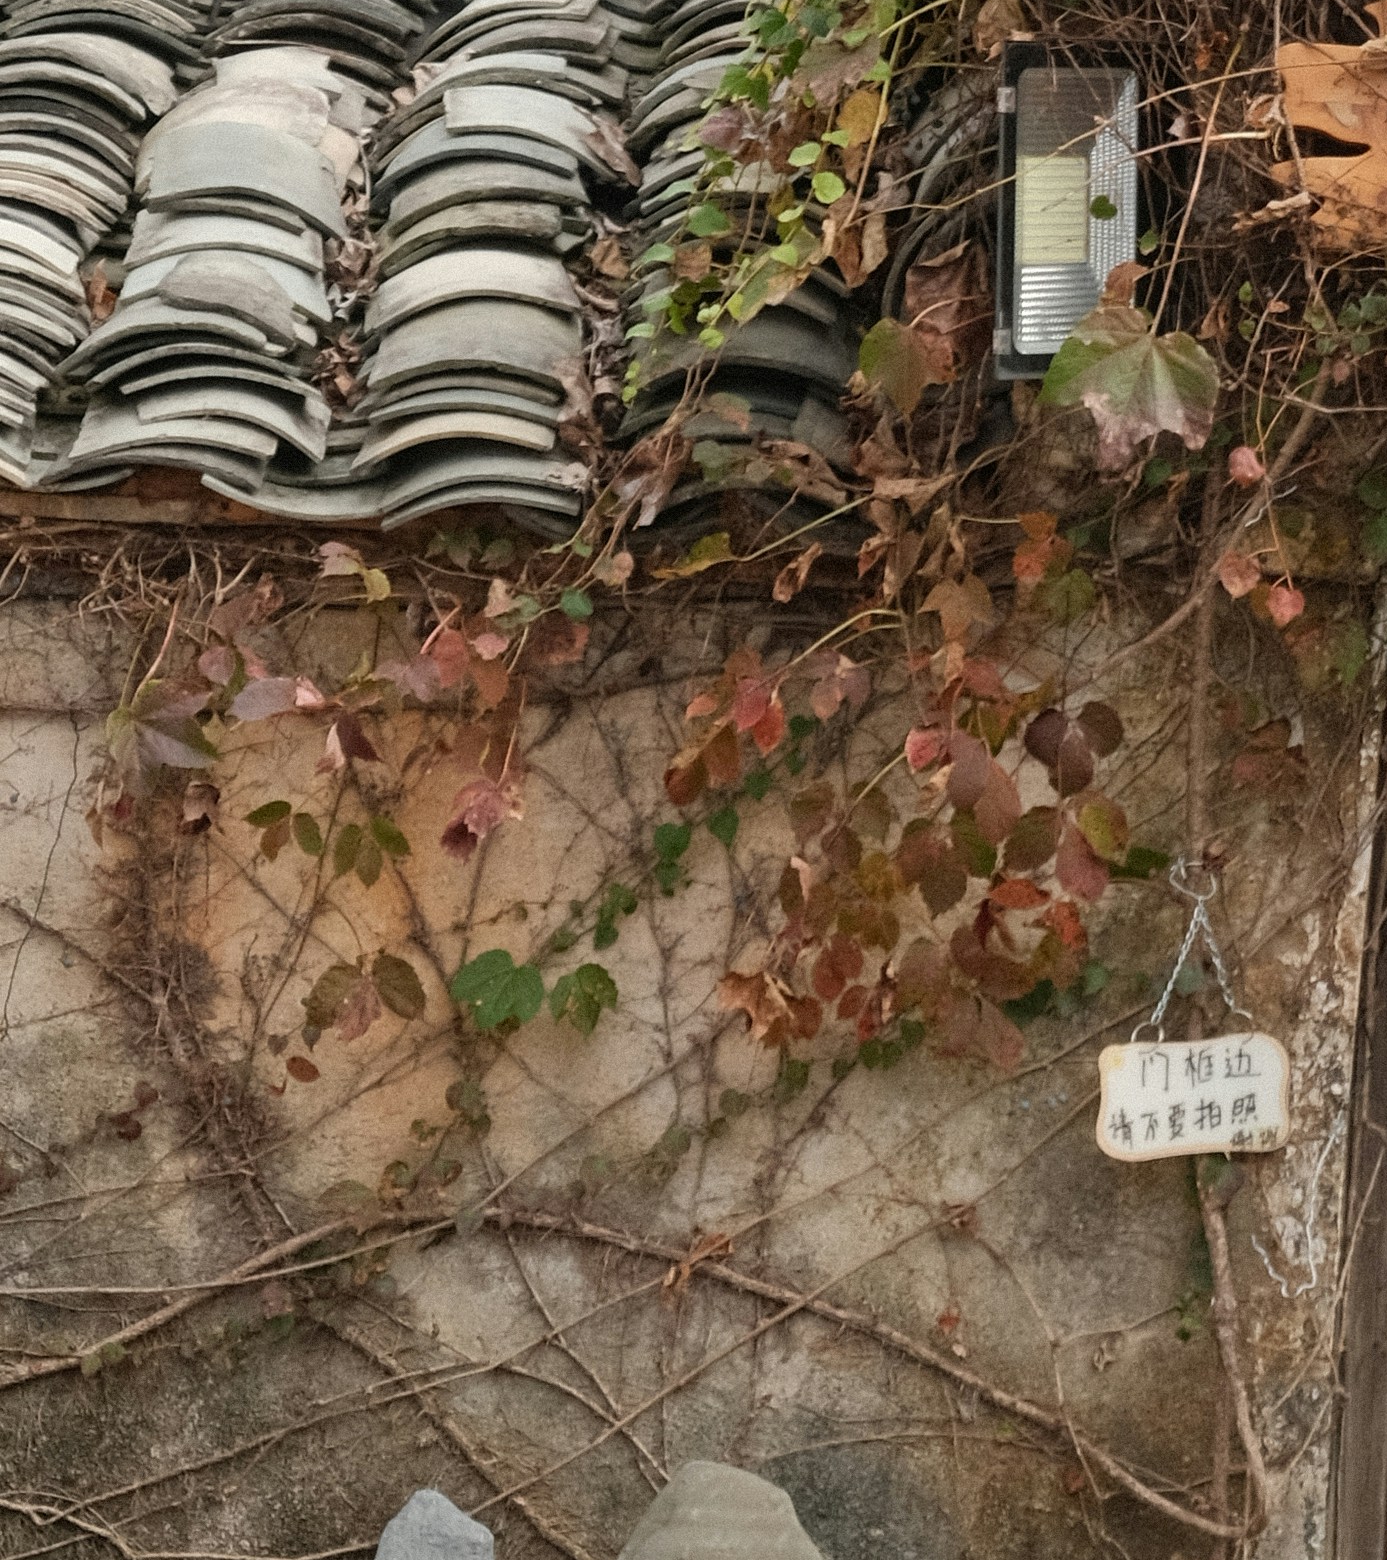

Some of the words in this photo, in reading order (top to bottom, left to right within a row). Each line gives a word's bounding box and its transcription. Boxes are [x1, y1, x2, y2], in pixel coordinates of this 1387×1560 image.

[1138, 1047, 1262, 1092] 门框边
[1108, 1092, 1259, 1150] 请不要拍照
